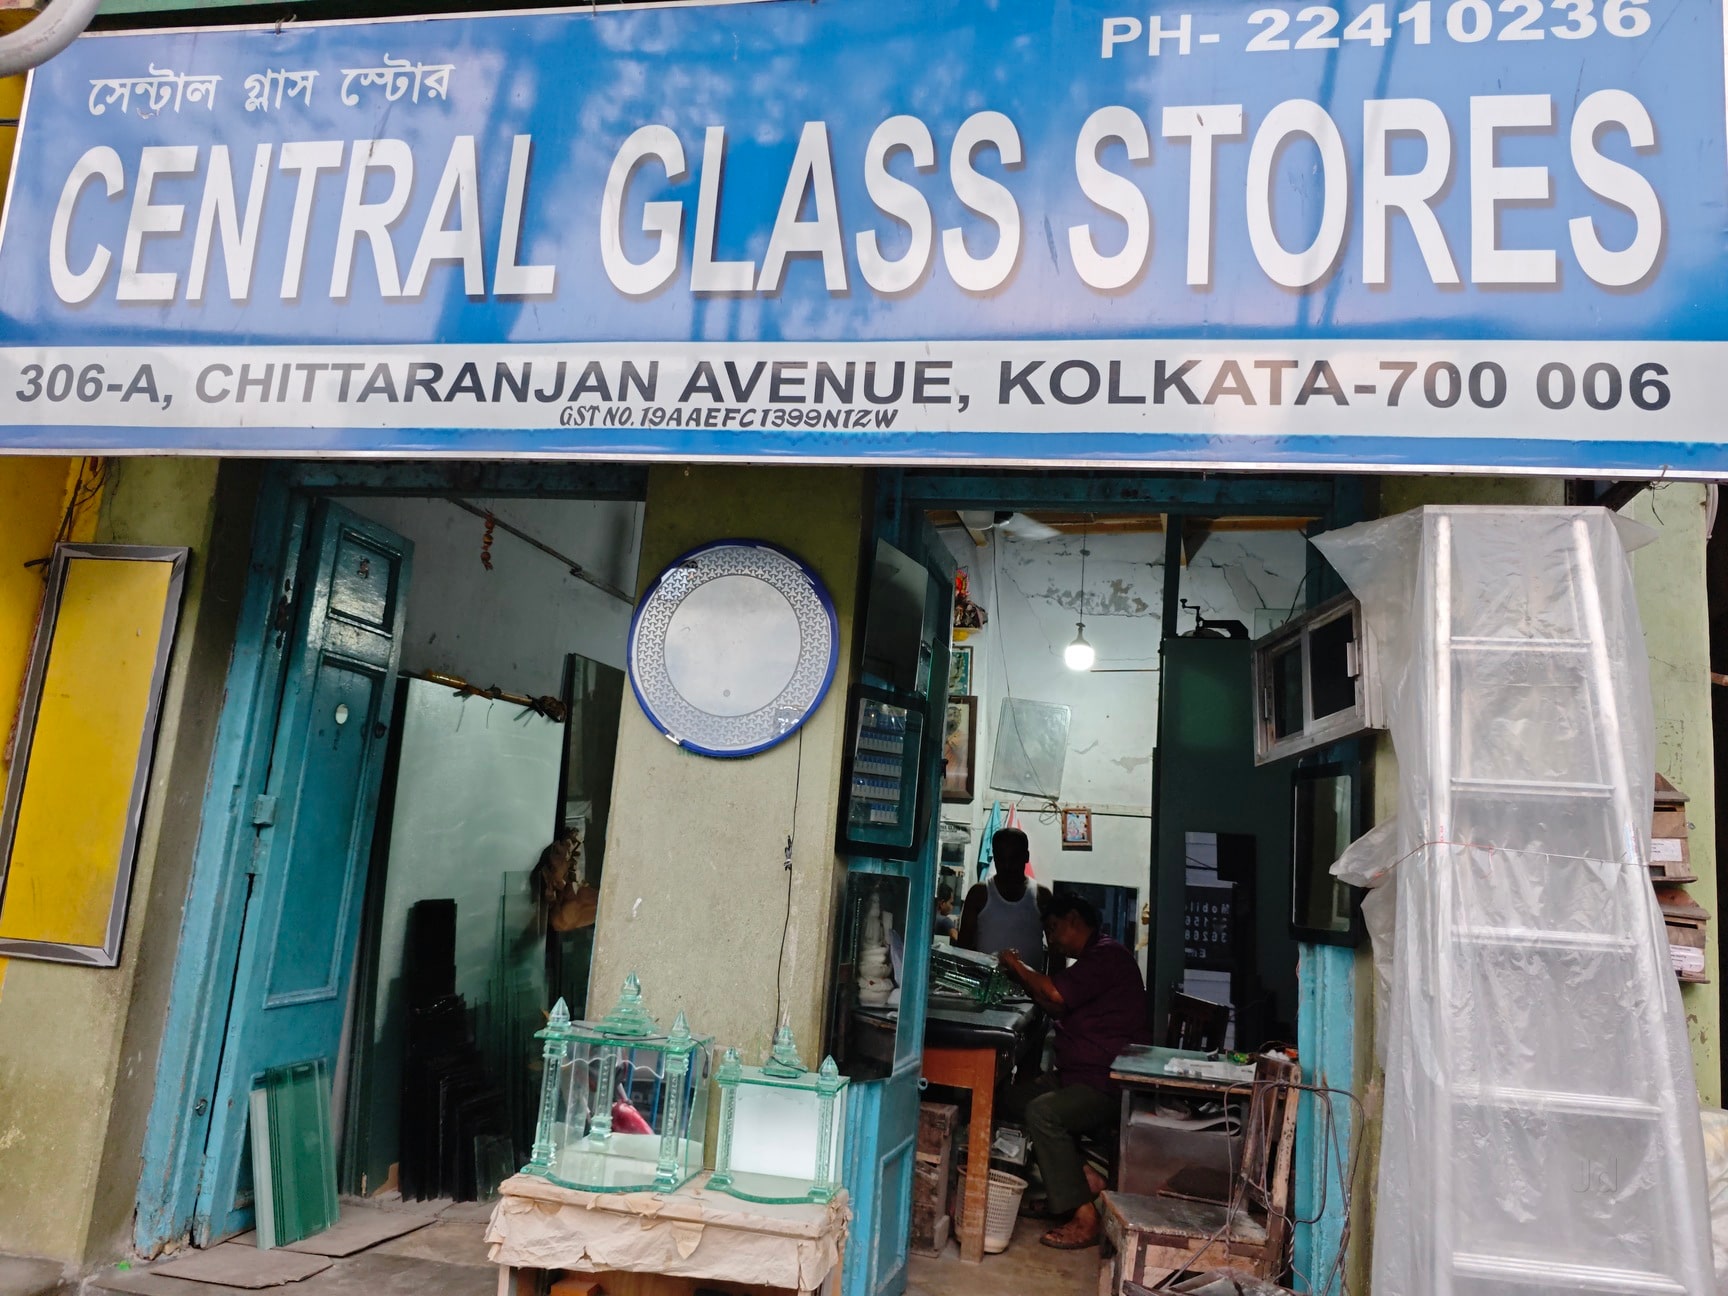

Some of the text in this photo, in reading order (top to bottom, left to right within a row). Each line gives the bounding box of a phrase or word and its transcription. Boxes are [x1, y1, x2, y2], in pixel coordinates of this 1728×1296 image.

[1103, 0, 1650, 57] PH- 22410236
[244, 68, 320, 112] গ্লাস
[341, 52, 456, 107] স্টোর
[49, 89, 1661, 304] CENTRAL GLASS STORES
[16, 360, 1671, 413] 306-A, CHITTARANJAN AVENUE, KOLKATA-700 006
[559, 405, 601, 427] GST
[602, 406, 635, 427] NO.
